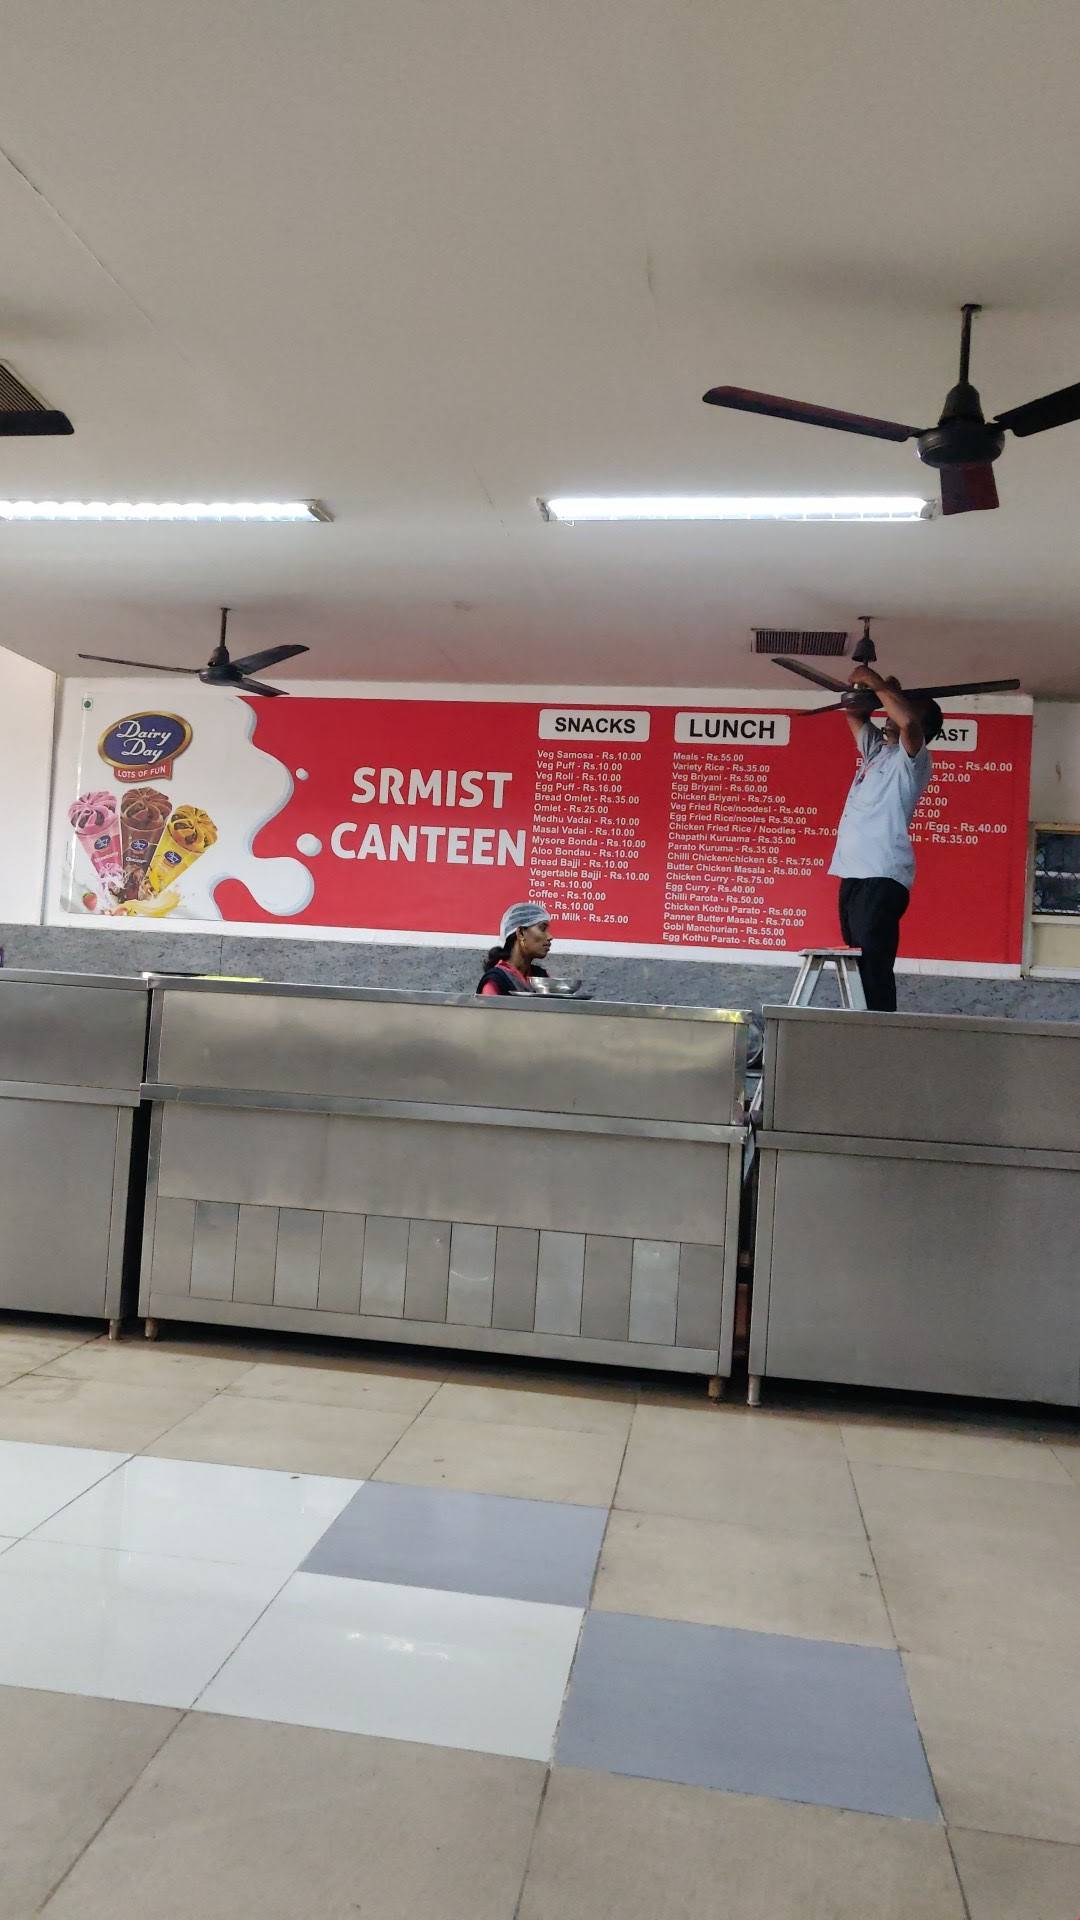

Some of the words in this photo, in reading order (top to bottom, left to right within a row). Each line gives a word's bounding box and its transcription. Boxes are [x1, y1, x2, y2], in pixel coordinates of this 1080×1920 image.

[555, 717, 636, 734] SNACKS
[689, 719, 775, 739] LUNCH
[117, 720, 172, 746] Dairy
[121, 738, 163, 764] Day
[537, 750, 554, 759] Veg
[557, 751, 593, 759] Samosa
[602, 752, 641, 761] Rs.10.00
[706, 754, 744, 762] Rs.55.00
[537, 761, 553, 770] Veg
[583, 763, 622, 771] Rs.10.00
[672, 763, 701, 772] Variety
[966, 761, 1012, 772] Rs.40.00
[112, 769, 136, 778] LOTS
[138, 769, 148, 777] OF
[150, 766, 166, 775] FUN
[536, 772, 552, 781] Veg
[555, 772, 573, 780] Roll
[582, 773, 621, 781] Rs.10.00
[672, 773, 688, 781] Veg
[690, 773, 721, 782] Briyani
[730, 775, 767, 783] Rs.50.00
[351, 767, 513, 809] SRMIST
[535, 783, 553, 792] Egg
[556, 783, 575, 791] Puff
[672, 783, 688, 791] Egg
[691, 783, 722, 792] Briyani
[730, 784, 768, 792] Rs.60.00
[565, 794, 591, 802] Omlet
[600, 795, 639, 804] Rs.35.00
[671, 793, 706, 801] Chicken
[709, 794, 739, 803] Briyani
[748, 795, 785, 803] Rs.75.00
[534, 804, 561, 812] Omlet
[569, 805, 608, 813] Rs.25.00
[670, 803, 686, 811] Veg
[689, 803, 711, 811] Fried
[779, 806, 817, 815] Rs.40.00
[534, 815, 564, 823] Medhu
[567, 816, 592, 824] Vadai
[600, 817, 639, 825] Rs.10.00
[669, 813, 687, 822] Egg
[689, 813, 711, 821] Fried
[768, 816, 806, 824] Rs.50.00
[562, 827, 587, 835] Vadai
[596, 828, 634, 836] Rs.10.00
[669, 823, 704, 831] Chicken
[707, 824, 729, 832] Fried
[759, 825, 796, 834] Noodles
[960, 822, 1007, 833] Rs.40.00
[532, 836, 565, 845] Mysore
[568, 837, 598, 846] Bonda
[606, 839, 646, 848] Rs.10.00
[669, 833, 707, 842] Chapathi
[758, 836, 796, 844] Rs.35.00
[932, 834, 978, 844] Rs.35.00
[330, 822, 526, 867] CANTEEN
[668, 843, 696, 851] Parato
[699, 844, 733, 852] Kuruma
[741, 846, 779, 854] Rs.35.00
[531, 847, 552, 855] Aloo
[599, 850, 638, 858] Rs.10.00
[530, 858, 557, 866] Bread
[560, 858, 580, 868] Bajji
[589, 860, 628, 869] Rs.10.00
[667, 853, 689, 861] Chilli
[692, 854, 764, 864] Chicken/chicken
[767, 856, 778, 864] 65
[786, 858, 824, 866] Rs.75.00
[530, 868, 578, 878] Vegertable
[581, 869, 601, 881] Bajji
[610, 872, 649, 881] Rs.10.00
[667, 863, 693, 871] Butter
[696, 864, 731, 873] Chicken
[734, 865, 765, 874] Masala
[773, 867, 811, 876] Rs.80.00
[529, 879, 545, 887] Tea
[554, 880, 592, 889] Rs.10.00
[666, 873, 701, 881] Chicken
[704, 874, 728, 884] Curry
[736, 876, 774, 884] Rs.75.00
[666, 883, 683, 892] Egg
[685, 884, 710, 893] Curry
[718, 885, 755, 894] Rs.40.00
[529, 889, 558, 898] Coffee
[567, 891, 606, 900] Rs.10.00
[665, 893, 687, 901] Chilli
[690, 894, 718, 902] Parota
[726, 895, 764, 904] Rs.50.00
[555, 902, 594, 911] Rs.10.00
[664, 903, 700, 911] Chicken
[702, 904, 728, 913] Kothu
[732, 906, 760, 914] Parato
[768, 908, 806, 917] Rs.60.00
[562, 913, 580, 921] Milk
[589, 914, 628, 923] Rs.25.00
[664, 913, 694, 921] Panner
[697, 914, 723, 923] Butter
[727, 916, 758, 924] Masala
[766, 918, 804, 927] Rs.70.00
[663, 923, 684, 931] Gobi
[686, 924, 738, 934] Manchurian
[746, 927, 784, 936] Rs.55.00
[663, 933, 680, 942] Egg
[682, 934, 708, 942] Kothu
[711, 935, 740, 944] Parato
[748, 937, 786, 946] Rs.60.00
